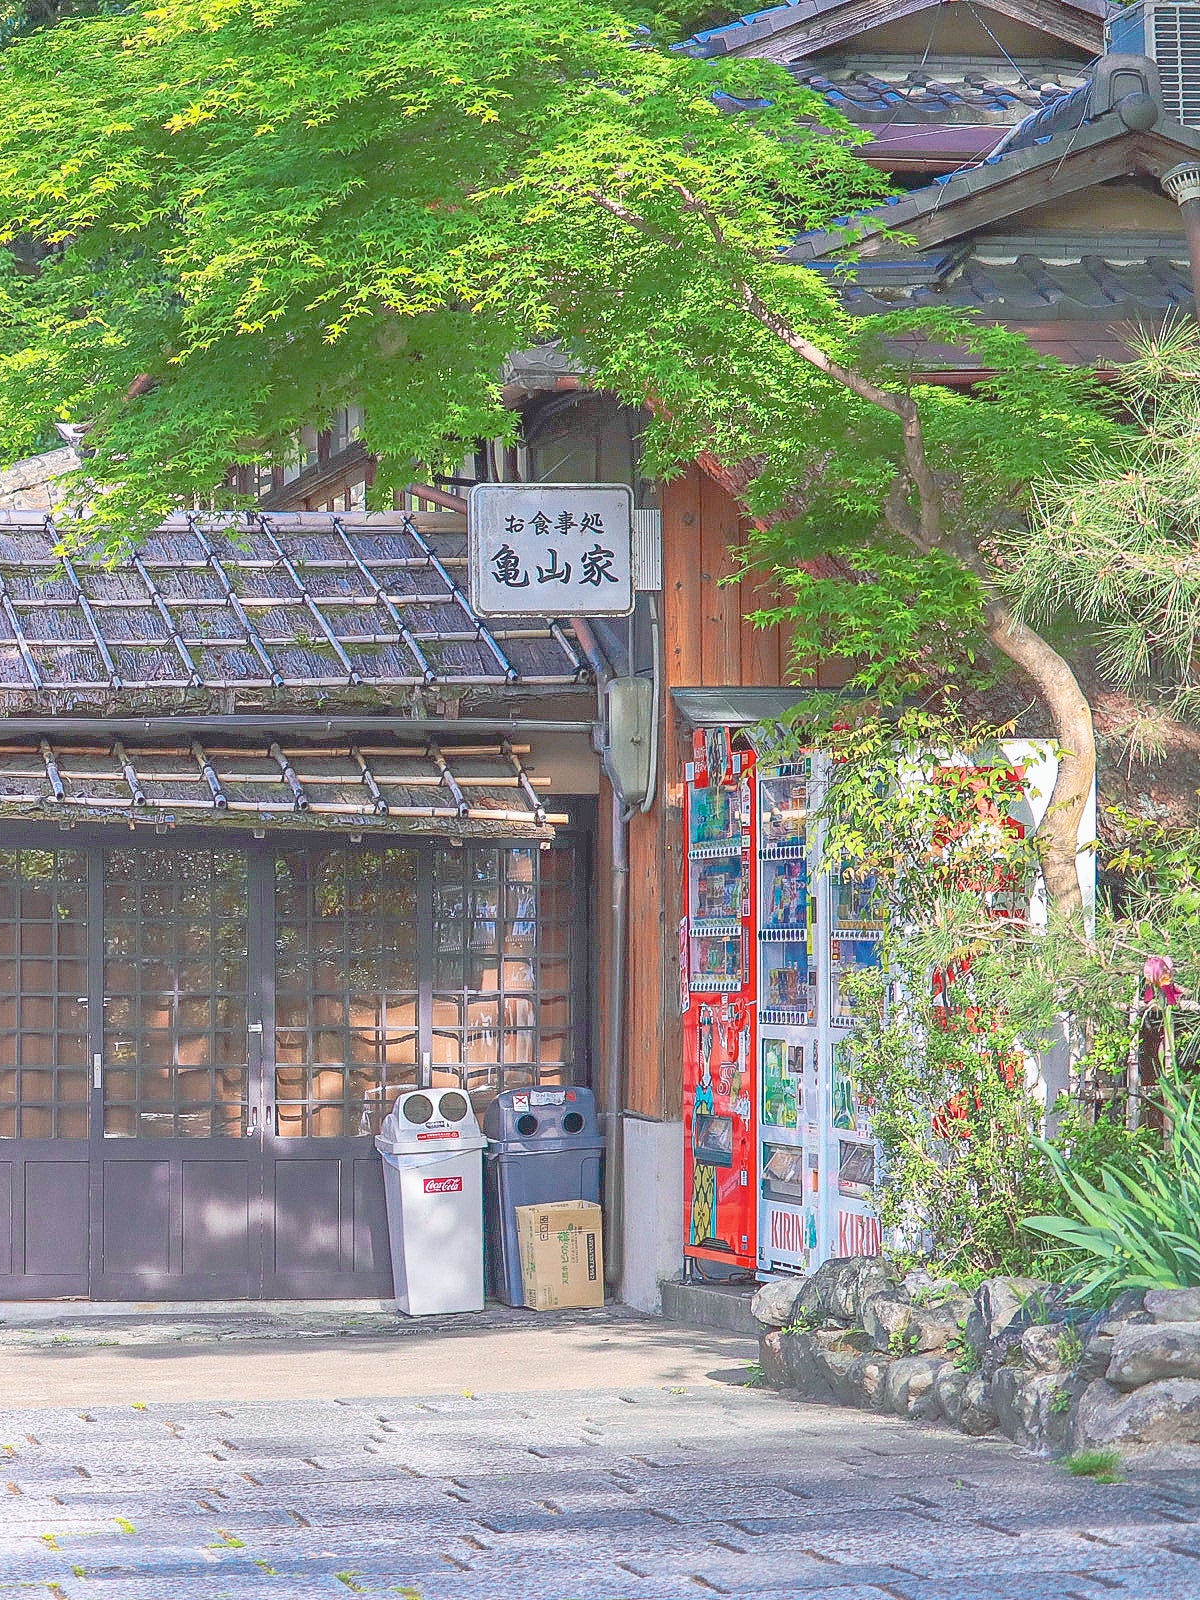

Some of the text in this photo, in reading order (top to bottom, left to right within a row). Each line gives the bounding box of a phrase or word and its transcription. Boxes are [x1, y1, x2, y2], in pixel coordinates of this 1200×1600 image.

[505, 510, 605, 536] お食事処
[490, 543, 620, 588] 亀山家
[771, 1210, 804, 1253] KIRIN
[839, 1210, 882, 1257] KIRIN
